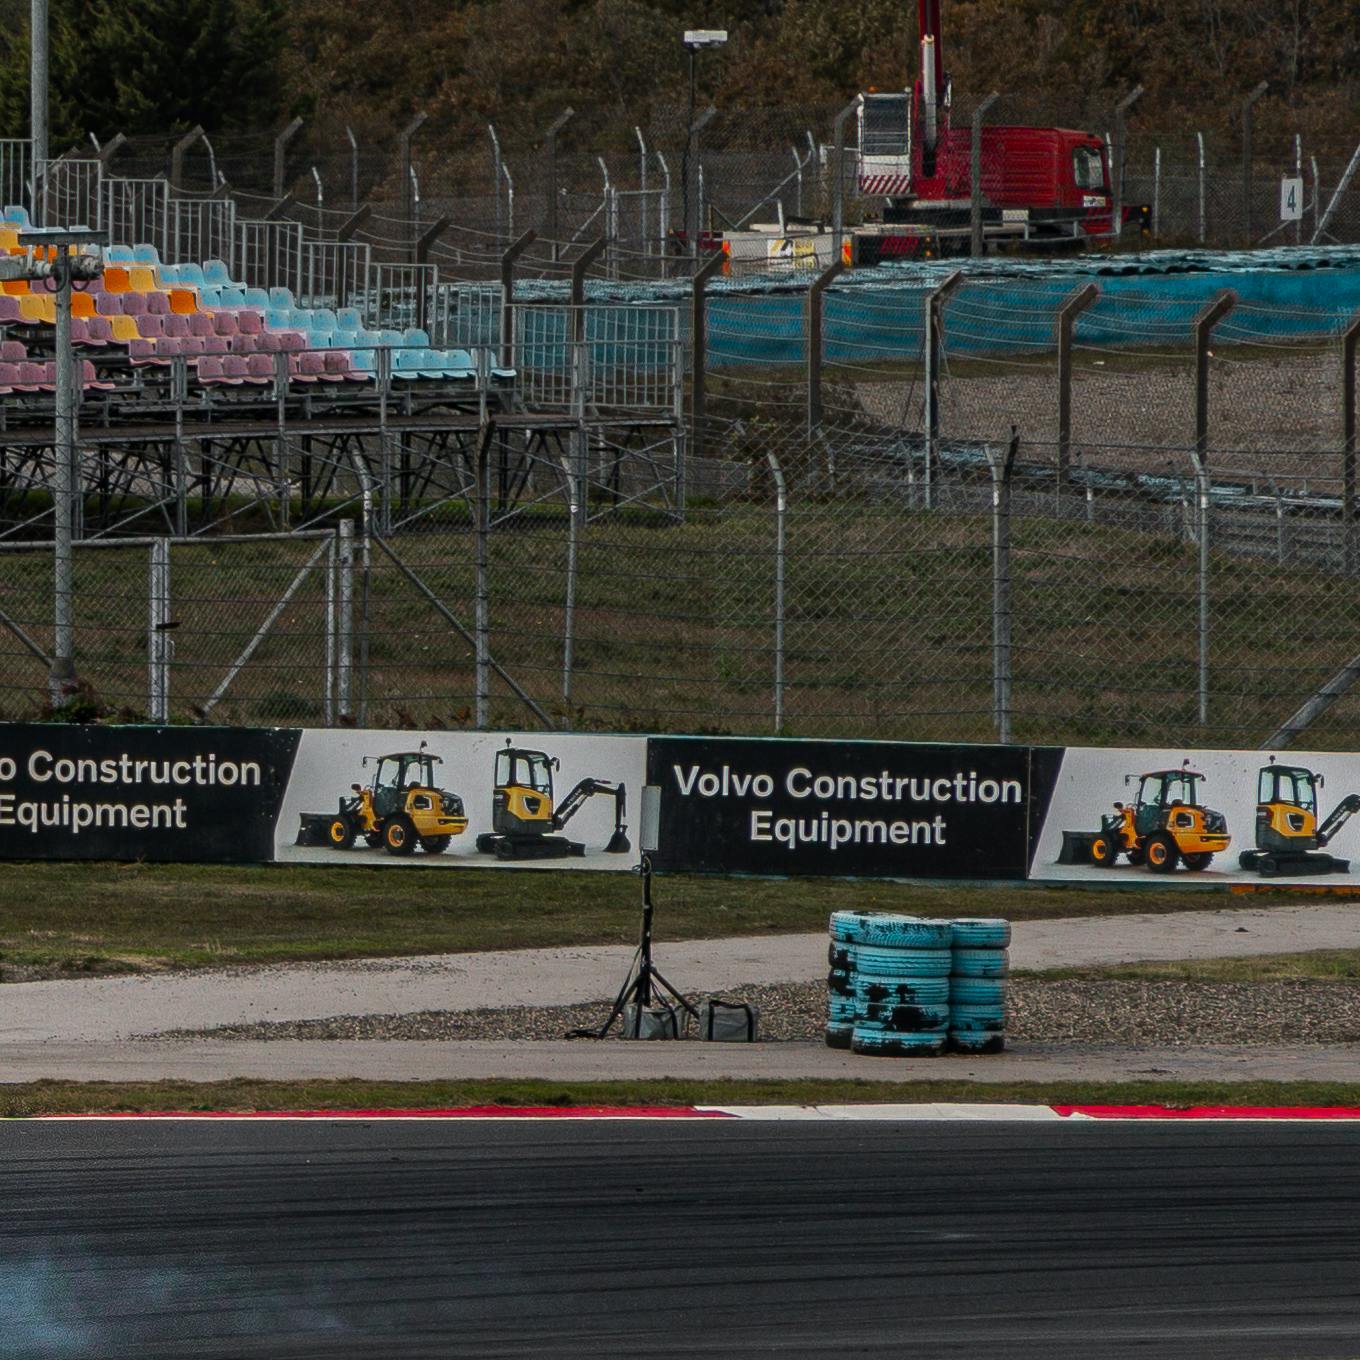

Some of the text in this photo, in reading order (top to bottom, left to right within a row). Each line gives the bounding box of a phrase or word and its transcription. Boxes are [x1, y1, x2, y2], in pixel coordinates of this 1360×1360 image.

[1287, 185, 1297, 213] 4
[28, 750, 261, 786] Construction
[674, 765, 1023, 804] Volvo Construction
[750, 811, 947, 850] Equipment
